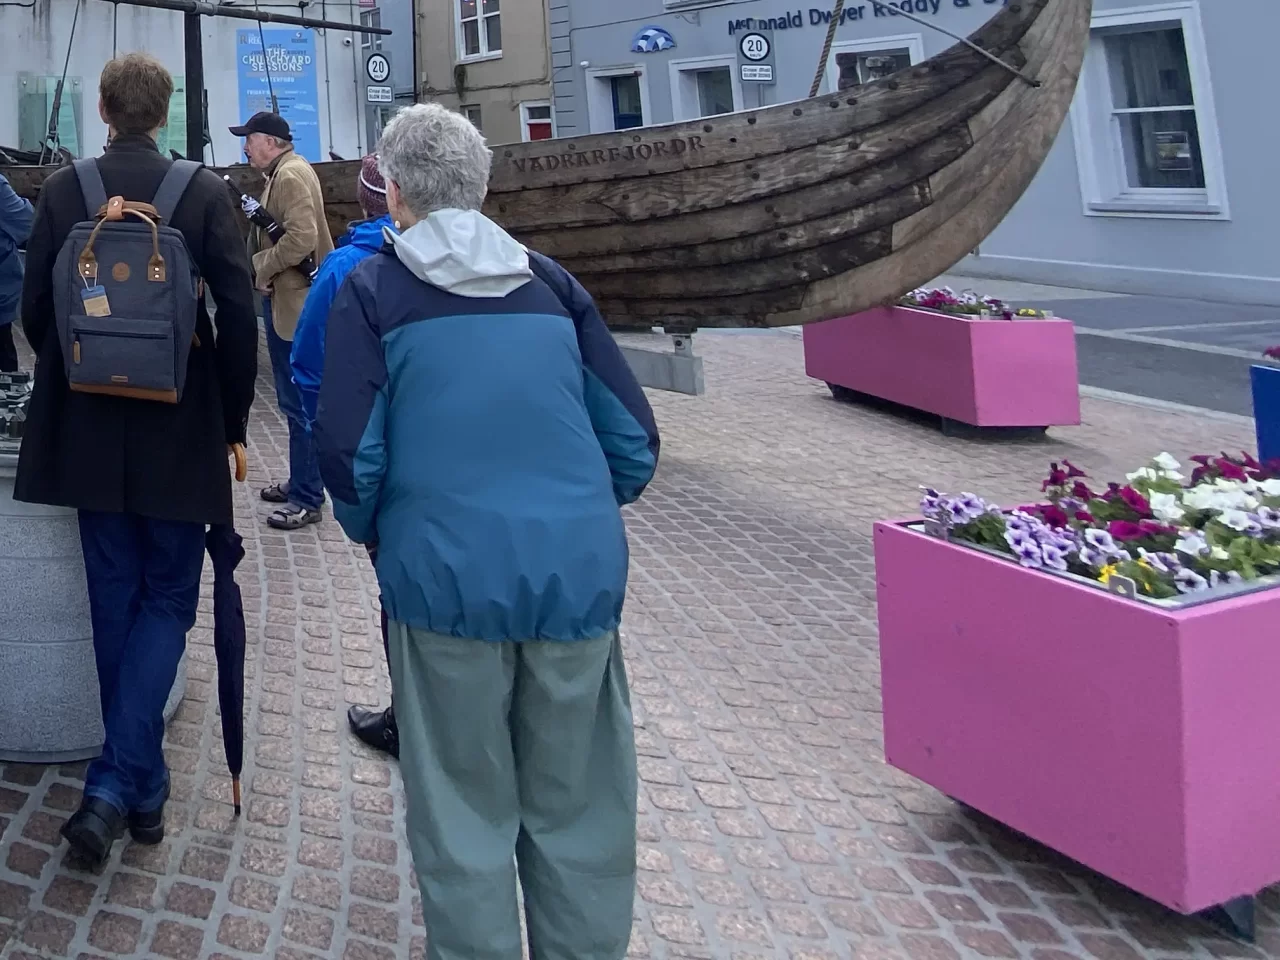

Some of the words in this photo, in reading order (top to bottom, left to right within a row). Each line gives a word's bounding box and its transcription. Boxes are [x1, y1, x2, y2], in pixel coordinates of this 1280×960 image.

[747, 39, 763, 52] 20
[266, 48, 287, 57] THE
[242, 55, 311, 65] CHURCHYARD
[252, 63, 303, 72] SESSIONS
[372, 60, 385, 74] 20
